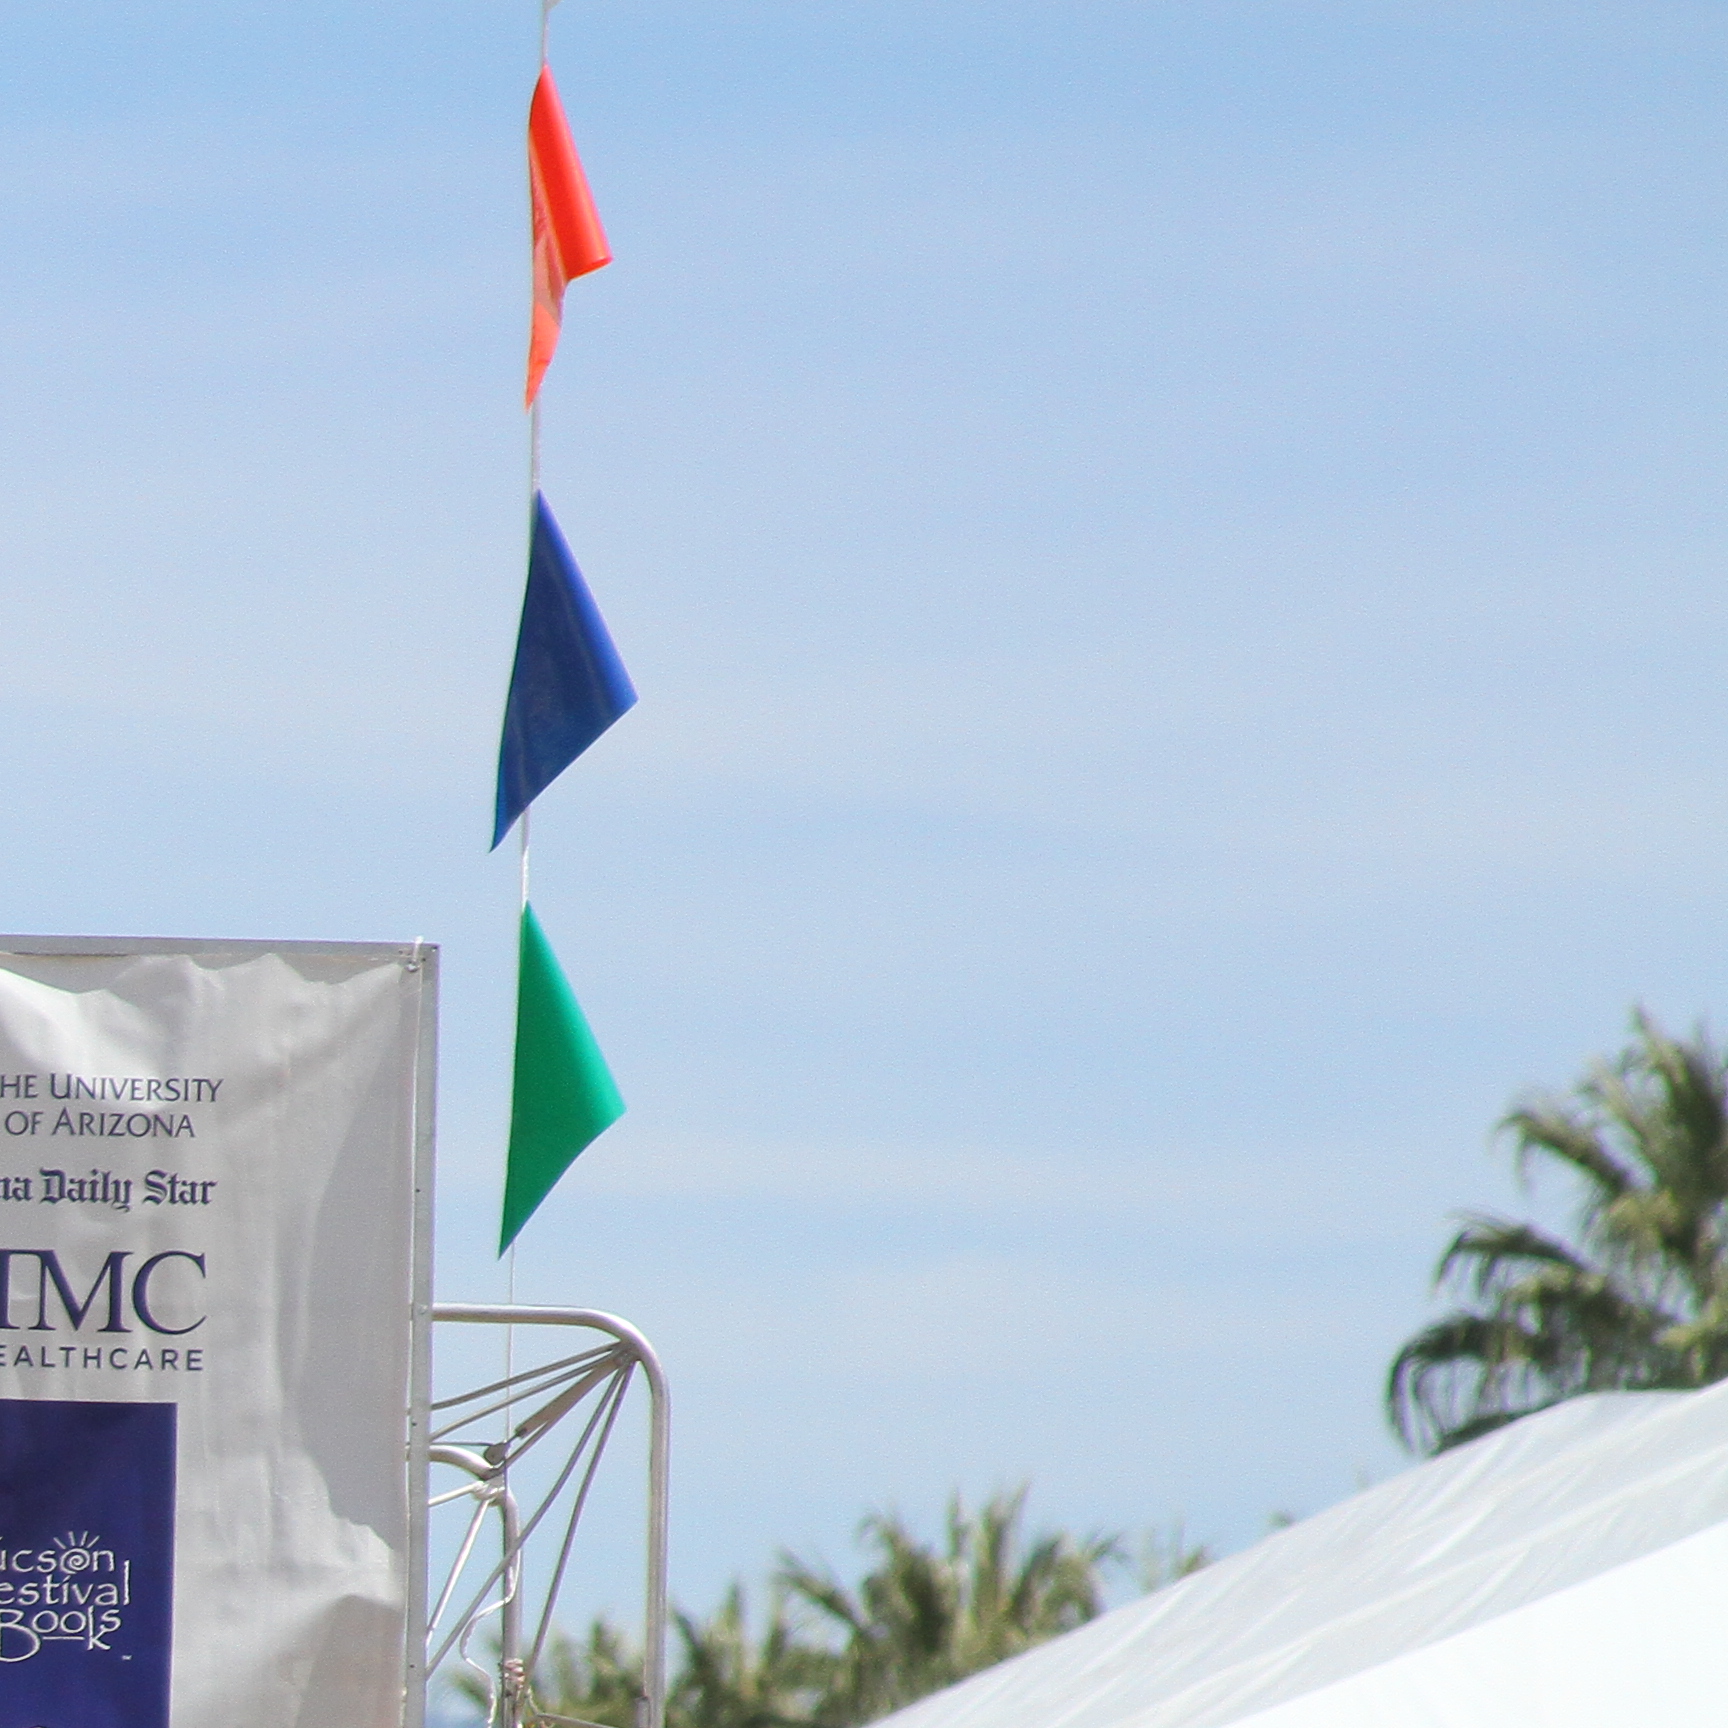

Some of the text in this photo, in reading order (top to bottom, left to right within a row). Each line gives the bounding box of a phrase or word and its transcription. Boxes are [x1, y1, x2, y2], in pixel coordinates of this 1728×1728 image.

[50, 1073, 225, 1103] UNIVERSITY
[4, 1106, 196, 1138] OF ARIZONA
[38, 1168, 134, 1213] Daily
[143, 1168, 219, 1206] Star
